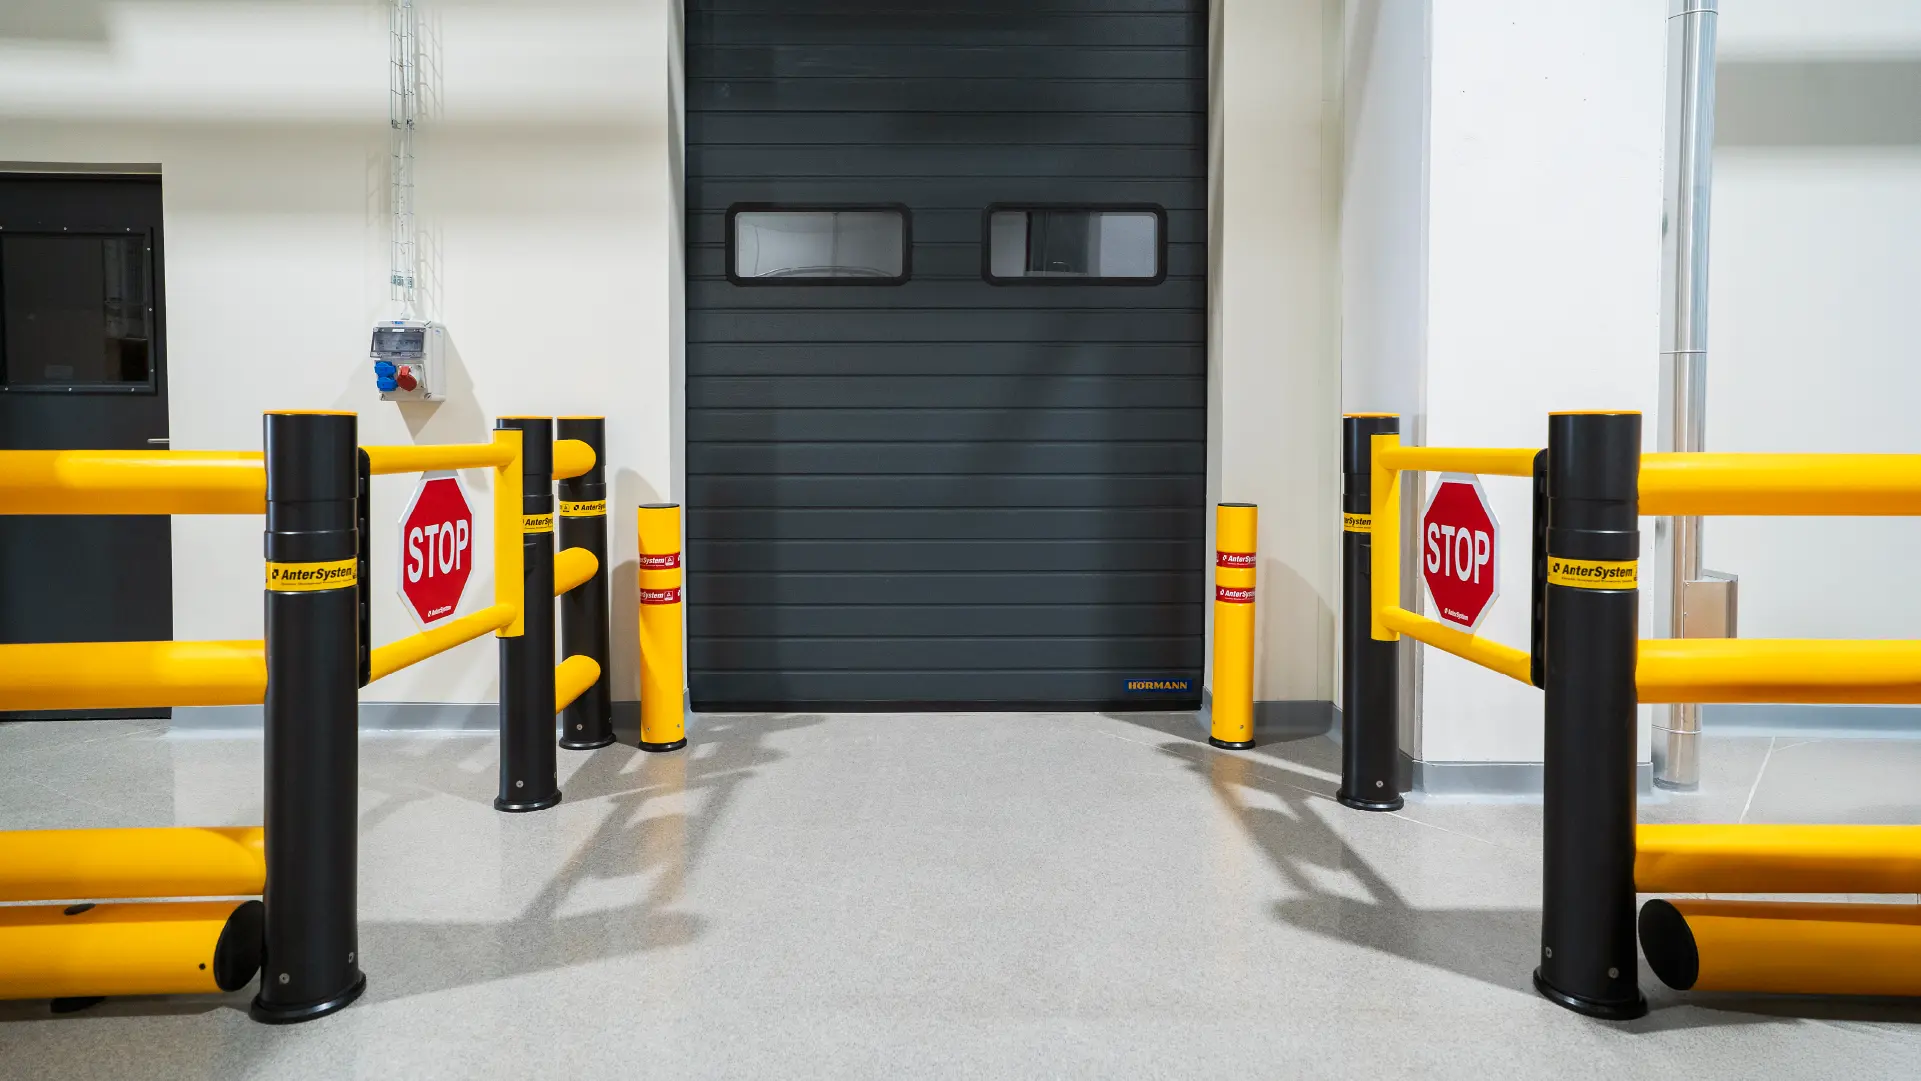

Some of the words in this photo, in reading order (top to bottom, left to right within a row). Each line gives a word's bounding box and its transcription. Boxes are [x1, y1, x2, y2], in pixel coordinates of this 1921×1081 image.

[407, 519, 469, 583] STOP
[1426, 522, 1490, 584] STOP
[281, 567, 352, 581] AnterSystem
[1561, 564, 1633, 579] AnterSystem
[1128, 680, 1188, 690] HÖRMANN
